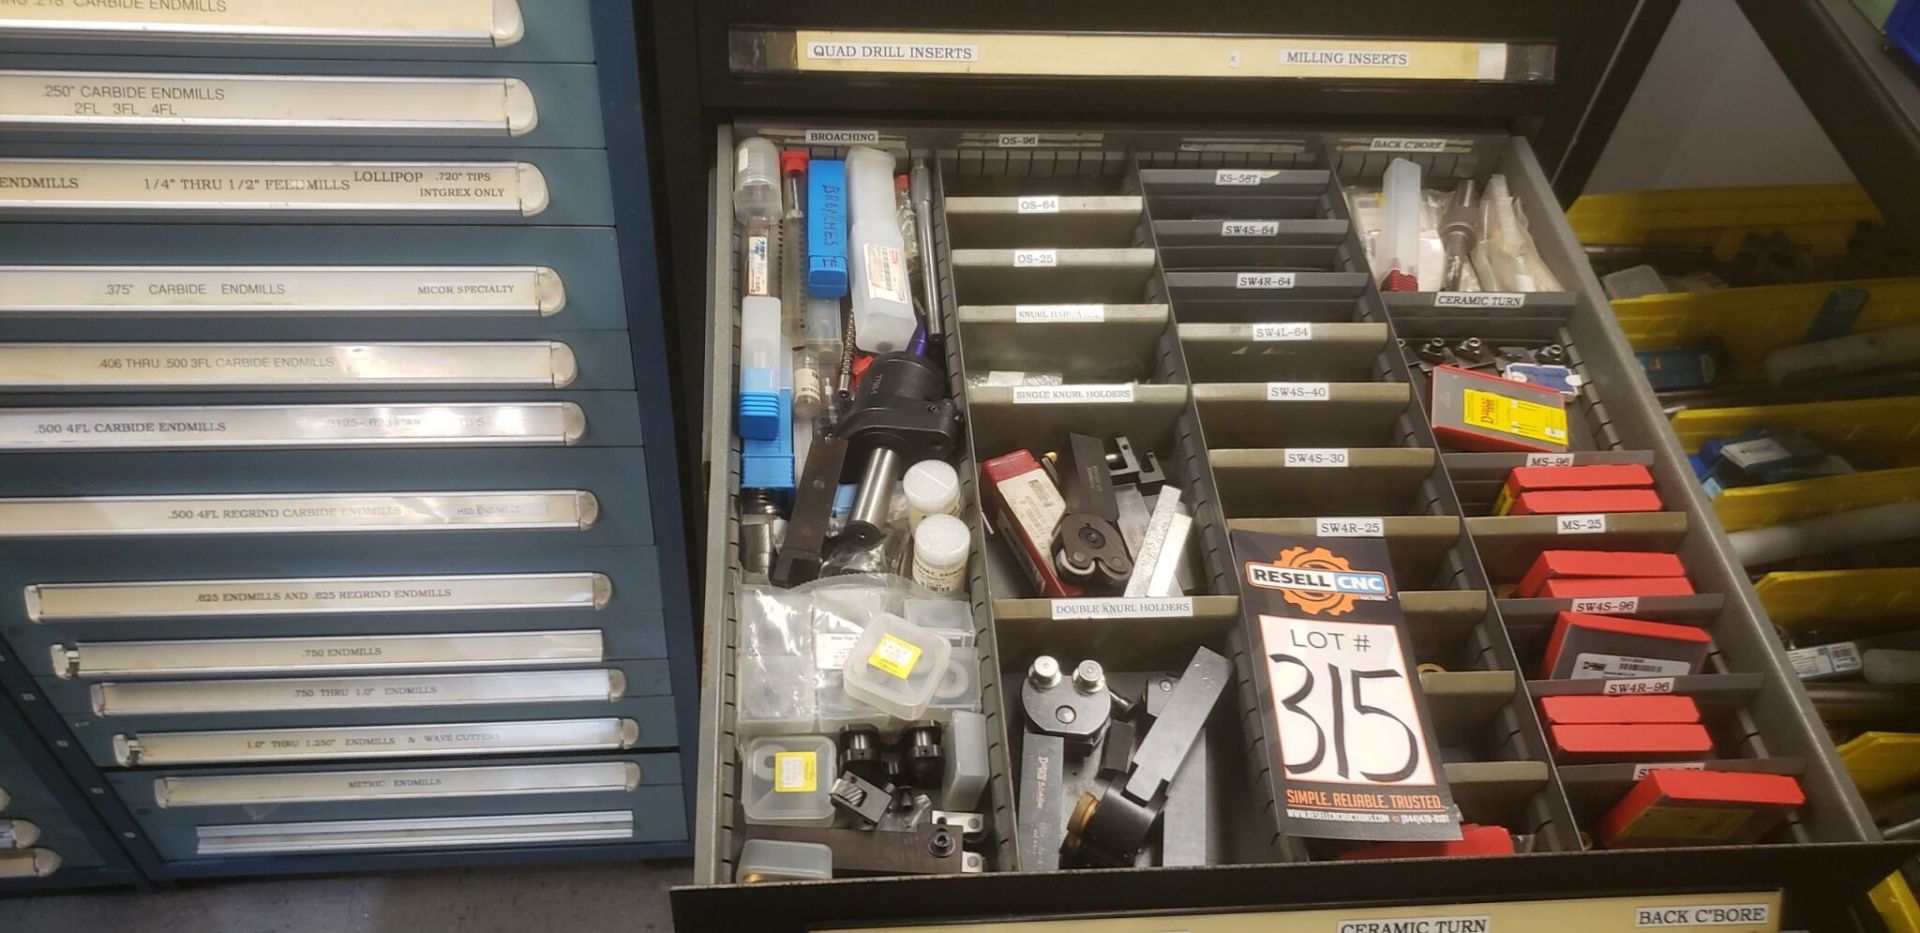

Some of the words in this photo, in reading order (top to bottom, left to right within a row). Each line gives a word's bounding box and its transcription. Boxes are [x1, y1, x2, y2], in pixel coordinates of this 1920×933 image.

[149, 0, 226, 13] ENDMILLS
[813, 45, 857, 57] QUAD
[861, 46, 905, 58] DRILL
[910, 47, 972, 60] INSERTS
[1286, 52, 1344, 65] MILLING
[1348, 53, 1407, 66] INSERTS
[42, 85, 75, 98] .250"
[80, 86, 146, 99] CARBIDE
[152, 88, 225, 101] ENDMILLS
[75, 103, 100, 115] 2FL
[113, 103, 139, 116] 3FL
[152, 104, 177, 116] 4FL
[810, 133, 876, 142] BROACHING
[1372, 140, 1400, 149] BACK
[0, 177, 79, 190] ENDMILLS
[144, 178, 175, 190] 1/4"
[180, 179, 222, 190] THRU
[229, 179, 260, 191] 1/2"
[265, 179, 350, 191] FEEDMILLS
[354, 171, 423, 183] LOLLIPOP
[435, 172, 463, 181] .720"
[466, 172, 491, 182] TIPS
[420, 188, 471, 197] INTGREX
[474, 188, 504, 197] ONLY
[1021, 199, 1056, 209] OS-64
[1225, 225, 1274, 234] SW4S-64
[1017, 255, 1053, 264] OS-25
[1240, 277, 1291, 286] SW4R-64
[104, 284, 134, 295] .375"
[148, 284, 206, 295] CARBIDE
[221, 284, 285, 295] ENDMILLS
[417, 285, 453, 295] MICOR
[457, 285, 514, 294] SPECIALTY
[1438, 296, 1488, 306] CERAMIC
[1491, 297, 1522, 306] TURN
[125, 358, 160, 369] THRU
[163, 358, 187, 369] .500
[190, 358, 212, 368] 3FL
[215, 358, 270, 368] CARBIDE
[274, 357, 334, 368] ENDMILLS
[1016, 390, 1050, 399] SINGLE
[1053, 391, 1084, 399] KNURL
[1086, 390, 1131, 399] HOLDERS
[1271, 387, 1326, 397] SW4S-40
[34, 423, 62, 434] .500
[66, 423, 90, 433] 4FL
[94, 423, 154, 434] CARBIDE
[159, 422, 226, 433] ENDMILLS
[1288, 454, 1344, 463] SW4S-30
[1530, 457, 1570, 467] MS-96
[168, 510, 193, 520] .500
[197, 510, 219, 519] 4FL
[223, 509, 279, 519] REGRIND
[283, 508, 337, 518] CARBIDE
[1321, 523, 1380, 533] SW4R-25
[1562, 520, 1602, 530] MS-25
[1253, 568, 1331, 588] RESELL
[1337, 576, 1383, 591] CNC
[223, 592, 281, 601] ENDMILLS
[284, 592, 308, 600] AND
[339, 590, 390, 599] REGRIND
[394, 589, 452, 598] ENDMILLS
[1056, 605, 1100, 614] DOUBLE
[1102, 604, 1137, 613] KNURL
[1140, 603, 1190, 612] HOLDERS
[1576, 601, 1635, 612] SW4S-96
[1290, 629, 1345, 650] LOT
[1353, 634, 1371, 653] #
[327, 647, 382, 656] ENDMILLS
[320, 689, 349, 697] THRU
[384, 686, 437, 695] ENDMILLS
[1608, 682, 1670, 694] SW4R-96
[1269, 653, 1419, 783] 315
[271, 739, 299, 748] THRU
[345, 737, 395, 746] ENDMILLS
[425, 734, 453, 743] WAVE
[394, 778, 442, 787] ENDMILLS
[1286, 789, 1331, 806] SIMPLE.
[1333, 793, 1389, 809] RELIABLE.
[1390, 795, 1446, 810] TRUSTED.
[1639, 909, 1689, 926] BACK
[1695, 906, 1765, 924] C'BORE
[1341, 921, 1429, 933] CERAMIC
[1435, 919, 1487, 933] TURN
